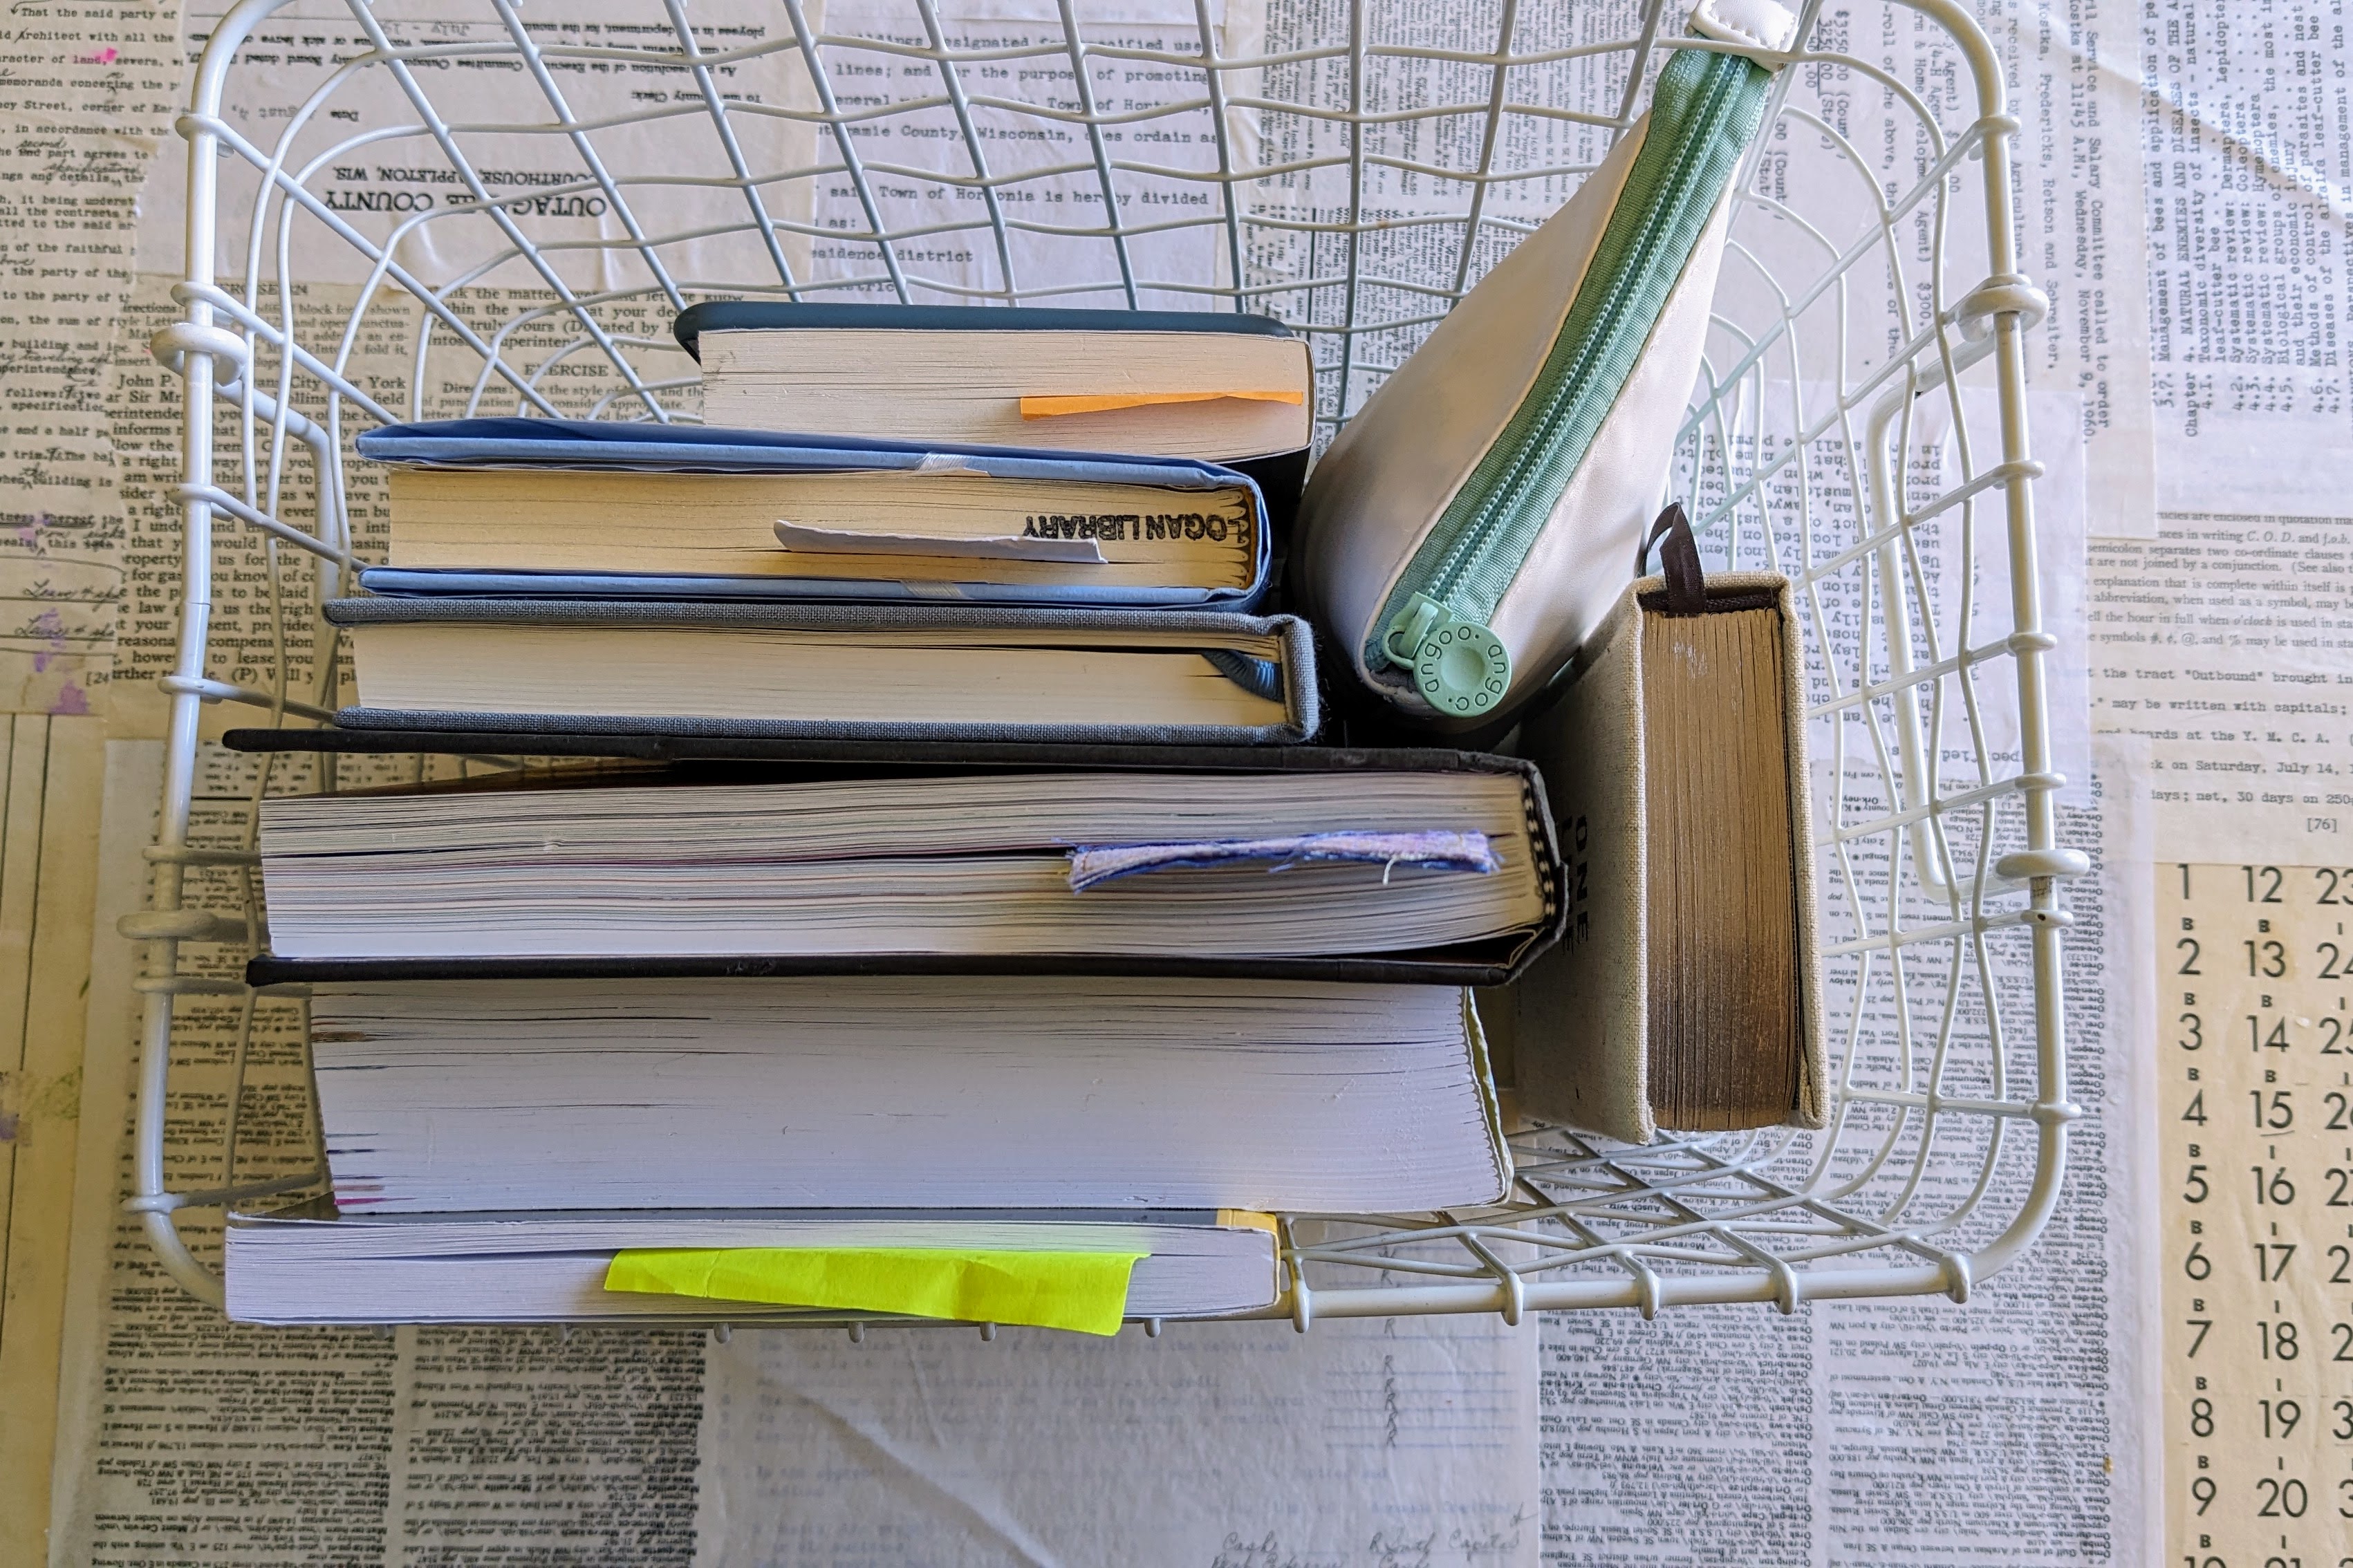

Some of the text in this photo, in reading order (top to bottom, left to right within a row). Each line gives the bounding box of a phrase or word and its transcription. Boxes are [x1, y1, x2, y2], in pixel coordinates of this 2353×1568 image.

[22, 8, 177, 19] That the said party of
[18, 31, 82, 41] Architect
[2008, 18, 2020, 88] received
[836, 64, 1207, 84] lines; and of promoting
[1914, 58, 1926, 93] Home
[2184, 3, 2200, 153] insects natural
[1047, 97, 1115, 110] Town of
[331, 111, 359, 122] Date
[2039, 73, 2055, 169] Fredericks,
[2296, 86, 2309, 167] parasites
[2334, 87, 2350, 178] management
[976, 129, 1072, 143] Wisconsin,
[1134, 132, 1191, 143] ordain
[2250, 93, 2267, 192] Hymenoptera
[1881, 120, 1896, 171] above,
[2235, 102, 2249, 192] Coleoptera
[48, 149, 75, 159] part
[84, 151, 126, 159] agrees
[332, 167, 366, 180] WIS.
[478, 169, 594, 186] OURTHOUSE,
[879, 186, 1209, 205] Town Horonia is herby divided
[2316, 158, 2330, 220] alfalfa
[324, 191, 434, 212] COUNTY
[2146, 55, 2170, 362] Management application
[2086, 31, 2110, 428] Service and Salary Committee called to order
[2167, 20, 2199, 437] Chapter NATURAL ENEMIES AND DISEASES OF THE
[66, 245, 122, 254] faithful
[899, 250, 973, 263] district
[3, 291, 89, 302] to party
[509, 289, 556, 299] matter
[613, 308, 647, 319] your
[2211, 263, 2226, 362] leaf-cutter
[2225, 273, 2244, 364] Systematic
[2273, 274, 2289, 365] Biological
[642, 321, 658, 335] by
[2078, 290, 2092, 363] November
[118, 374, 154, 389] John
[369, 377, 405, 389] York
[114, 424, 171, 435] informs
[1022, 514, 1140, 540] LIBRARY
[131, 537, 162, 548] that
[2087, 543, 2344, 559] semicolon separates co-ordinate clauses
[2143, 558, 2282, 572] joined conjunction.
[2094, 577, 2257, 592] explanation complete
[2094, 592, 2311, 609] abbreviation, symbol,
[136, 622, 170, 633] your
[232, 668, 257, 683] (P)
[2135, 669, 2175, 680] tract
[2273, 672, 2327, 684] brought
[2168, 700, 2347, 716] written with capitals;
[2276, 762, 2309, 774] July
[2317, 764, 2339, 775] 14,
[2237, 792, 2294, 804] 30 days
[2307, 818, 2338, 833] [76]
[2177, 864, 2285, 904] 1 12
[2182, 918, 2271, 933] B B
[2177, 937, 2287, 978] 2 13
[2184, 993, 2273, 1008] B B
[2179, 1013, 2290, 1052] 3 14
[2188, 1068, 2276, 1083] B B
[2182, 1088, 2294, 1130] 4 15
[2189, 1144, 2201, 1157] B
[2184, 1165, 2296, 1204] 5 16
[2191, 1221, 2202, 1234] B
[2185, 1242, 2296, 1282] 6 17
[2193, 1299, 2205, 1312] B
[2186, 1320, 2299, 1361] 7 18
[2196, 1376, 2207, 1390] B
[2191, 1398, 2301, 1439] 8 19
[2192, 1476, 2308, 1518] 9 20
